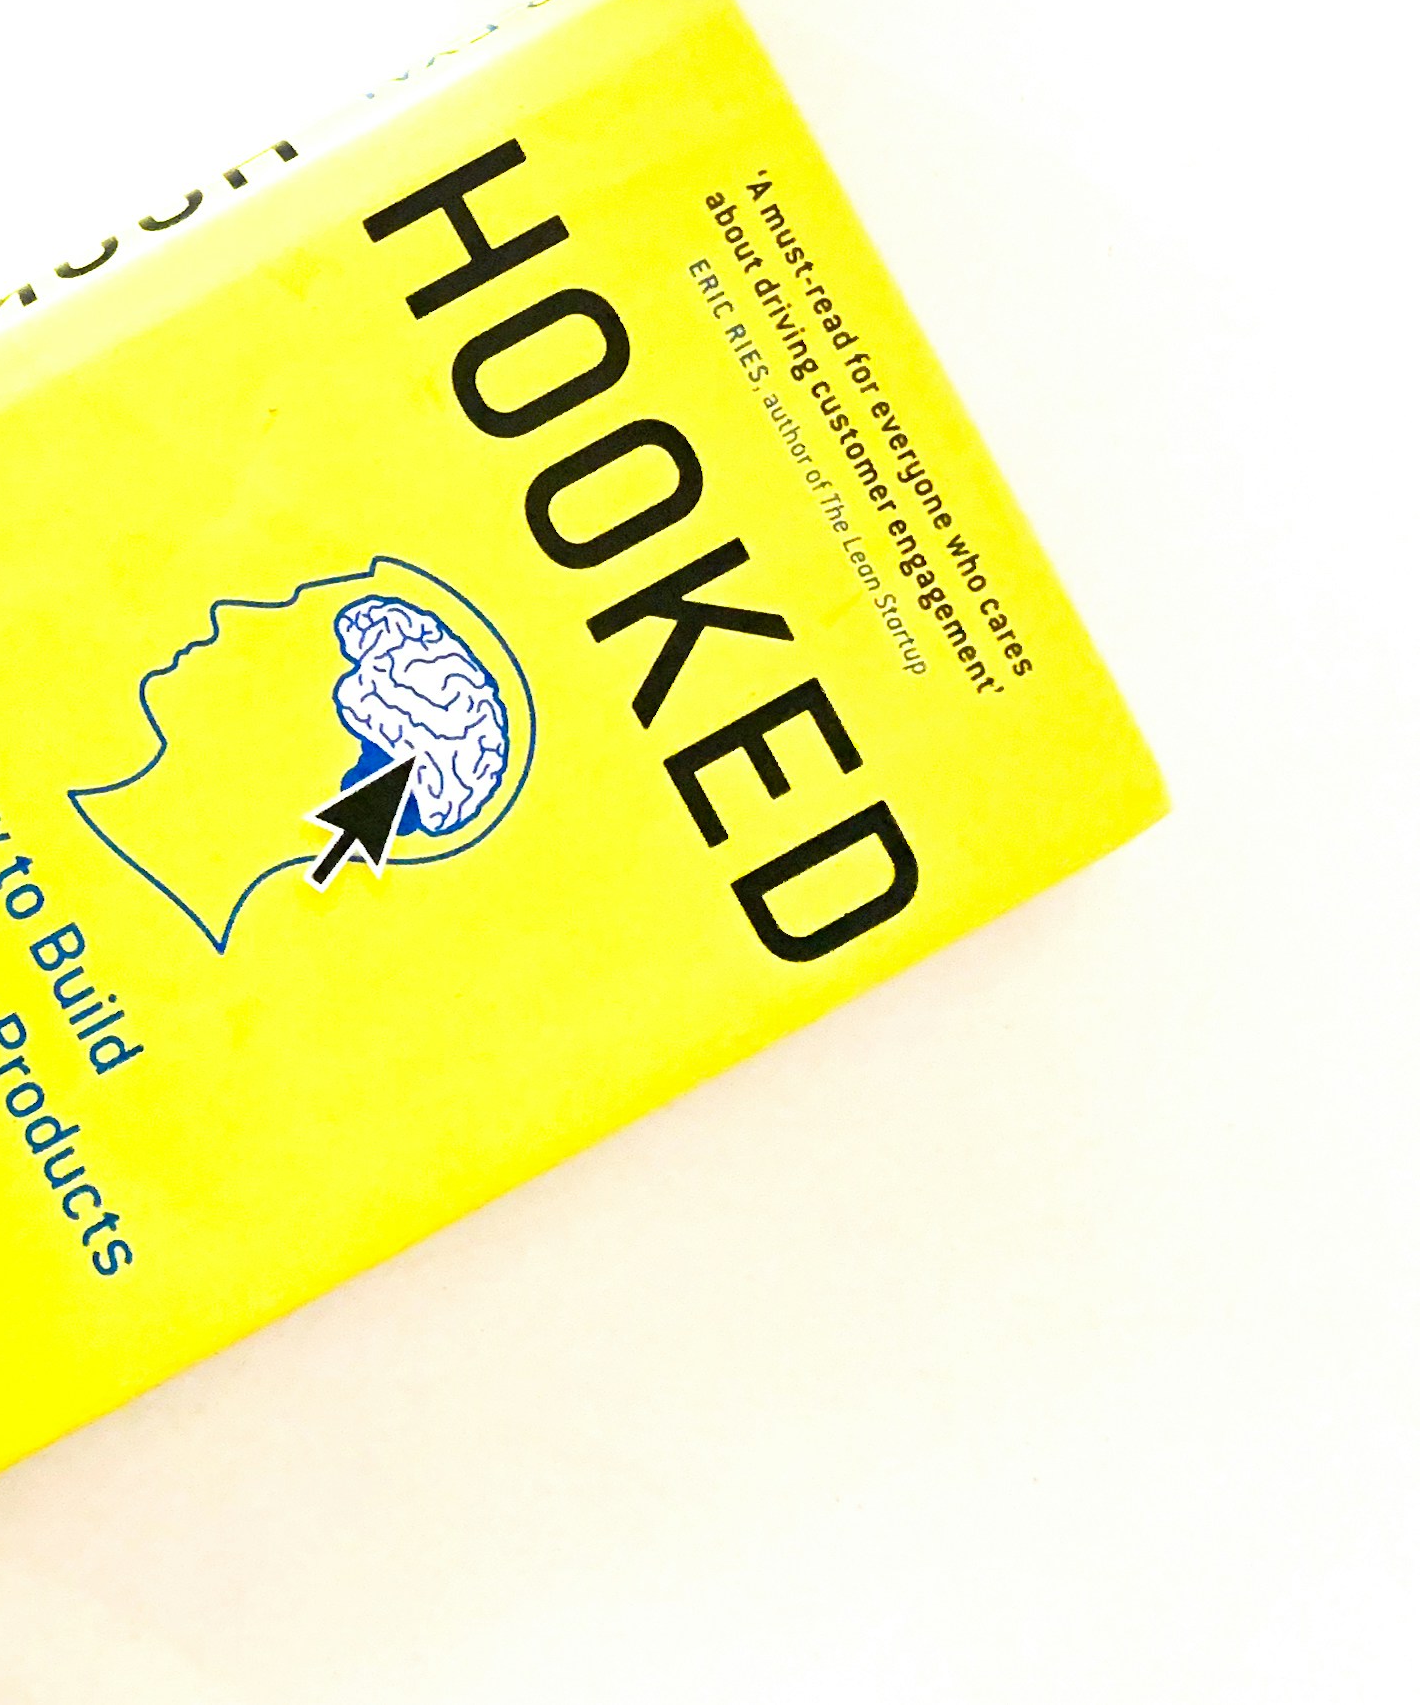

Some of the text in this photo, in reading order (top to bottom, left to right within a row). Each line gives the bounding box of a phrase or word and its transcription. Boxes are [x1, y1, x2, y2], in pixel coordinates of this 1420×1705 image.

[362, 138, 919, 962] HOOKED
[689, 259, 926, 674] ERIC RIES, author of The Lean Startup
[706, 192, 763, 273] about
[754, 279, 819, 381] driving
[811, 381, 896, 511] customer
[760, 204, 859, 350] must-read
[844, 354, 879, 393] for
[871, 402, 952, 530] everyone
[946, 534, 986, 592] who
[980, 599, 1032, 676] cares
[29, 922, 144, 1075] Build
